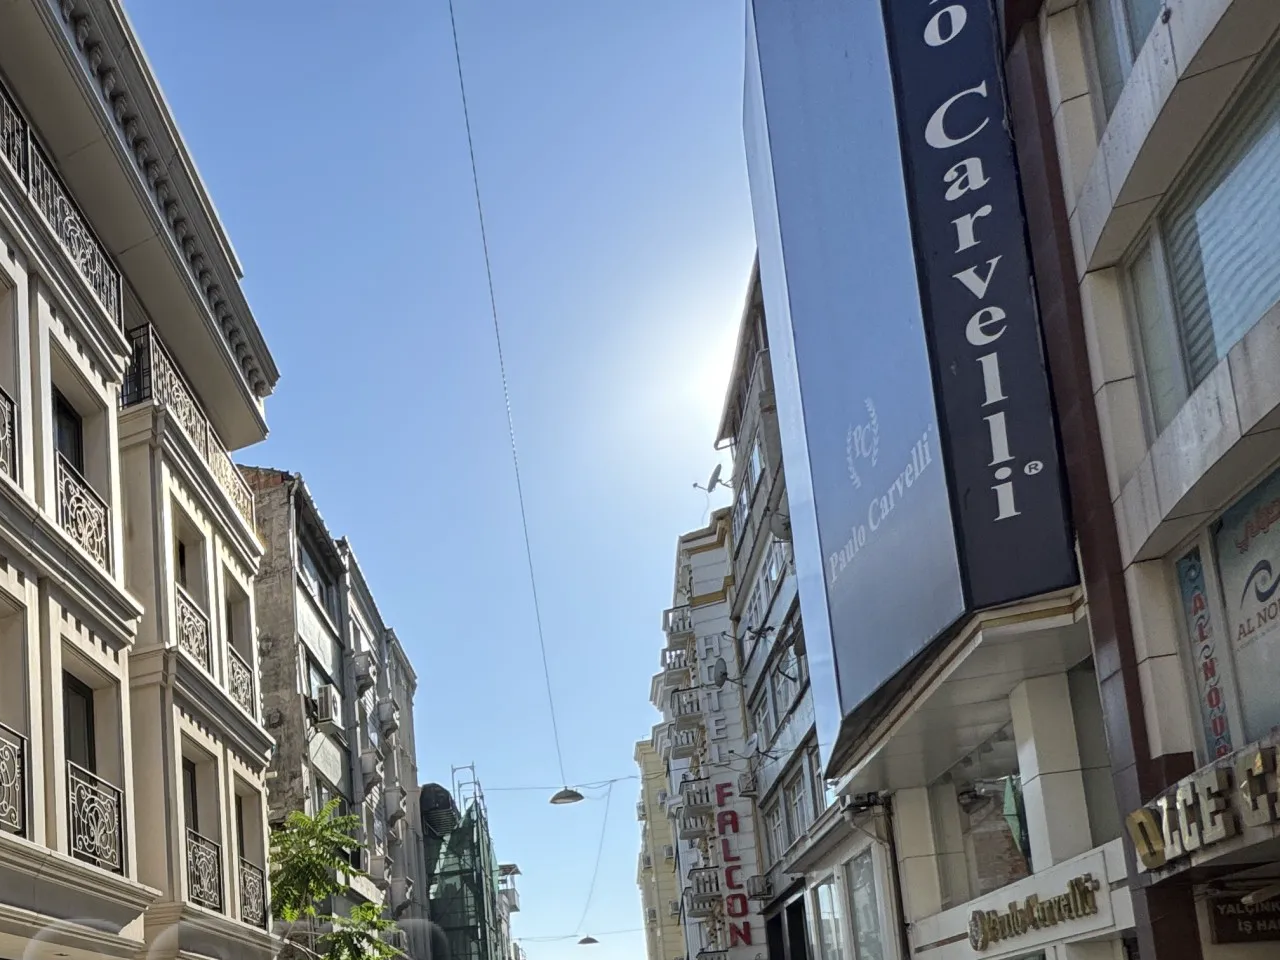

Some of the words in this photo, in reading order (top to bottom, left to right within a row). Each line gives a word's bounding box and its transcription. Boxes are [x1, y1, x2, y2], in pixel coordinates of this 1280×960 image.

[924, 79, 1021, 522] Carvelli
[827, 524, 867, 584] Paulo
[867, 434, 933, 533] Carvelli
[1236, 618, 1256, 641] AL
[715, 781, 752, 947] FALCON
